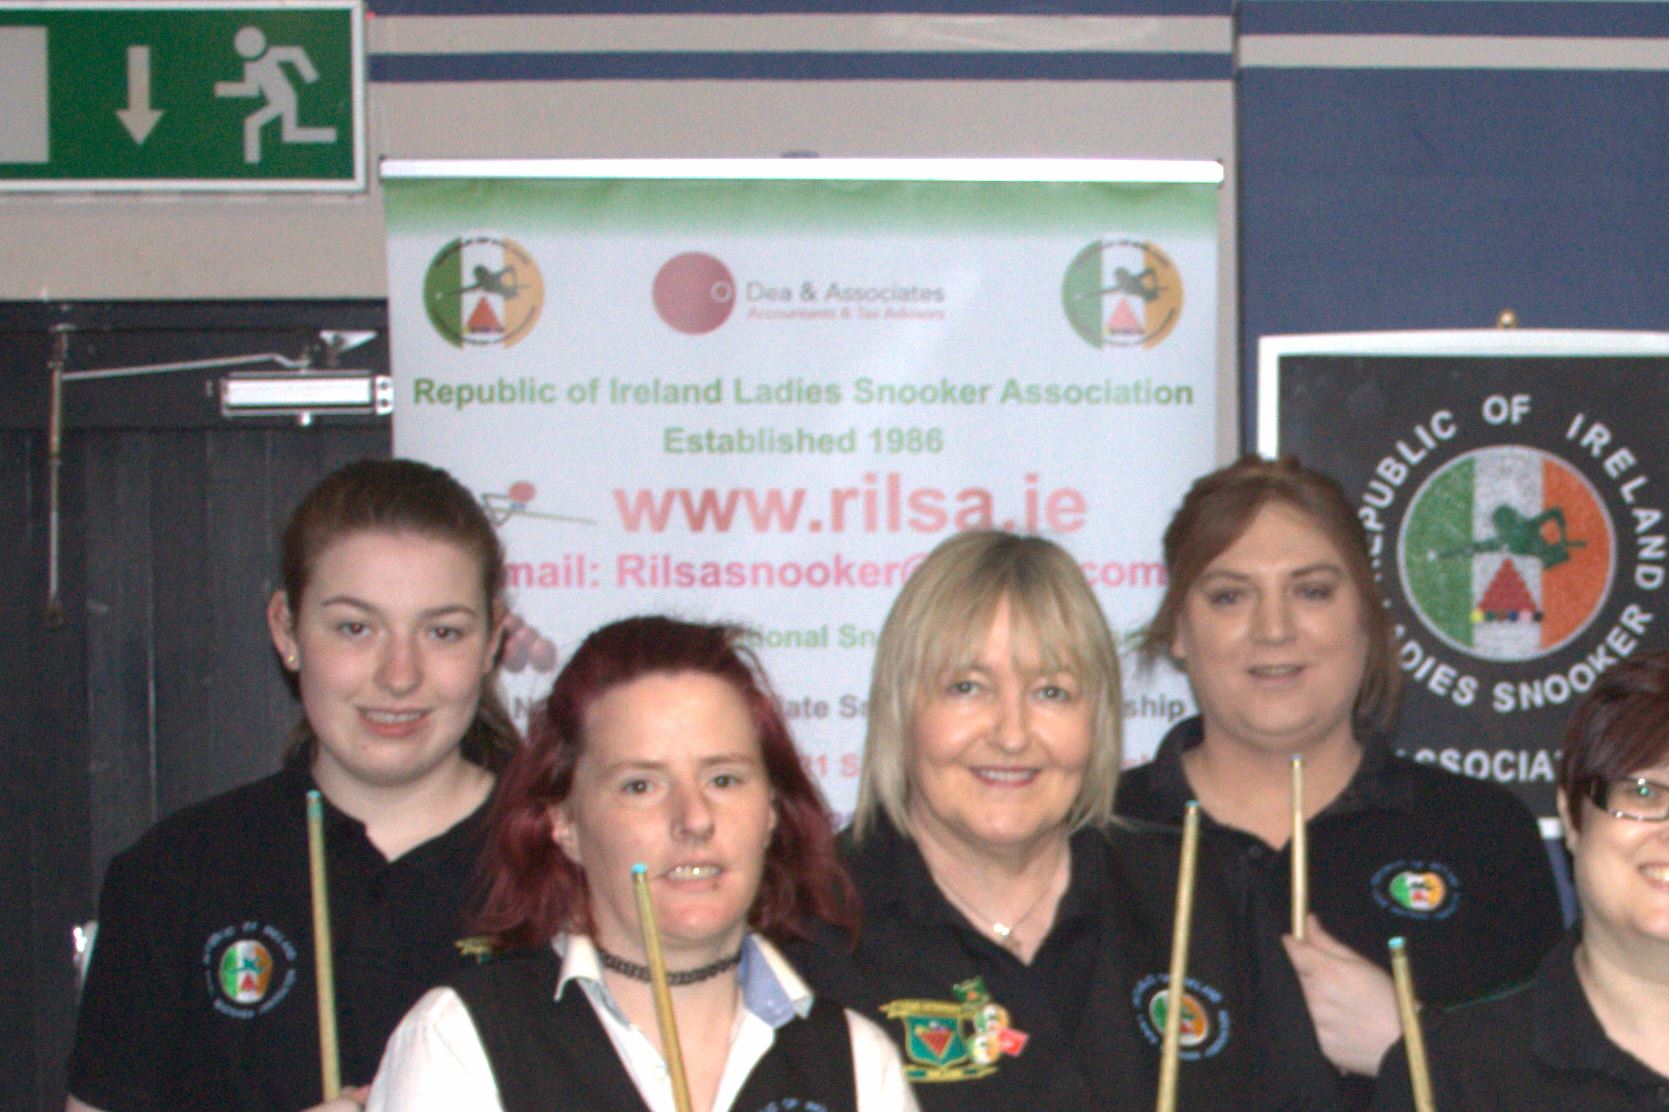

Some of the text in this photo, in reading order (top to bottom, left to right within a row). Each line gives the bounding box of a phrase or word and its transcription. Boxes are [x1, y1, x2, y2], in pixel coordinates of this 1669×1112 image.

[746, 280, 945, 302] Dea & Associates
[413, 376, 1195, 409] Republic of Ireland Ladies Snooker Association
[663, 426, 943, 453] Established 1986
[611, 472, 1087, 534] www.rilsa.ie
[1482, 394, 1531, 426] OF
[1565, 413, 1667, 590] IRELAND
[505, 552, 599, 589] mail:
[1396, 603, 1654, 713] DIES SNOOKER
